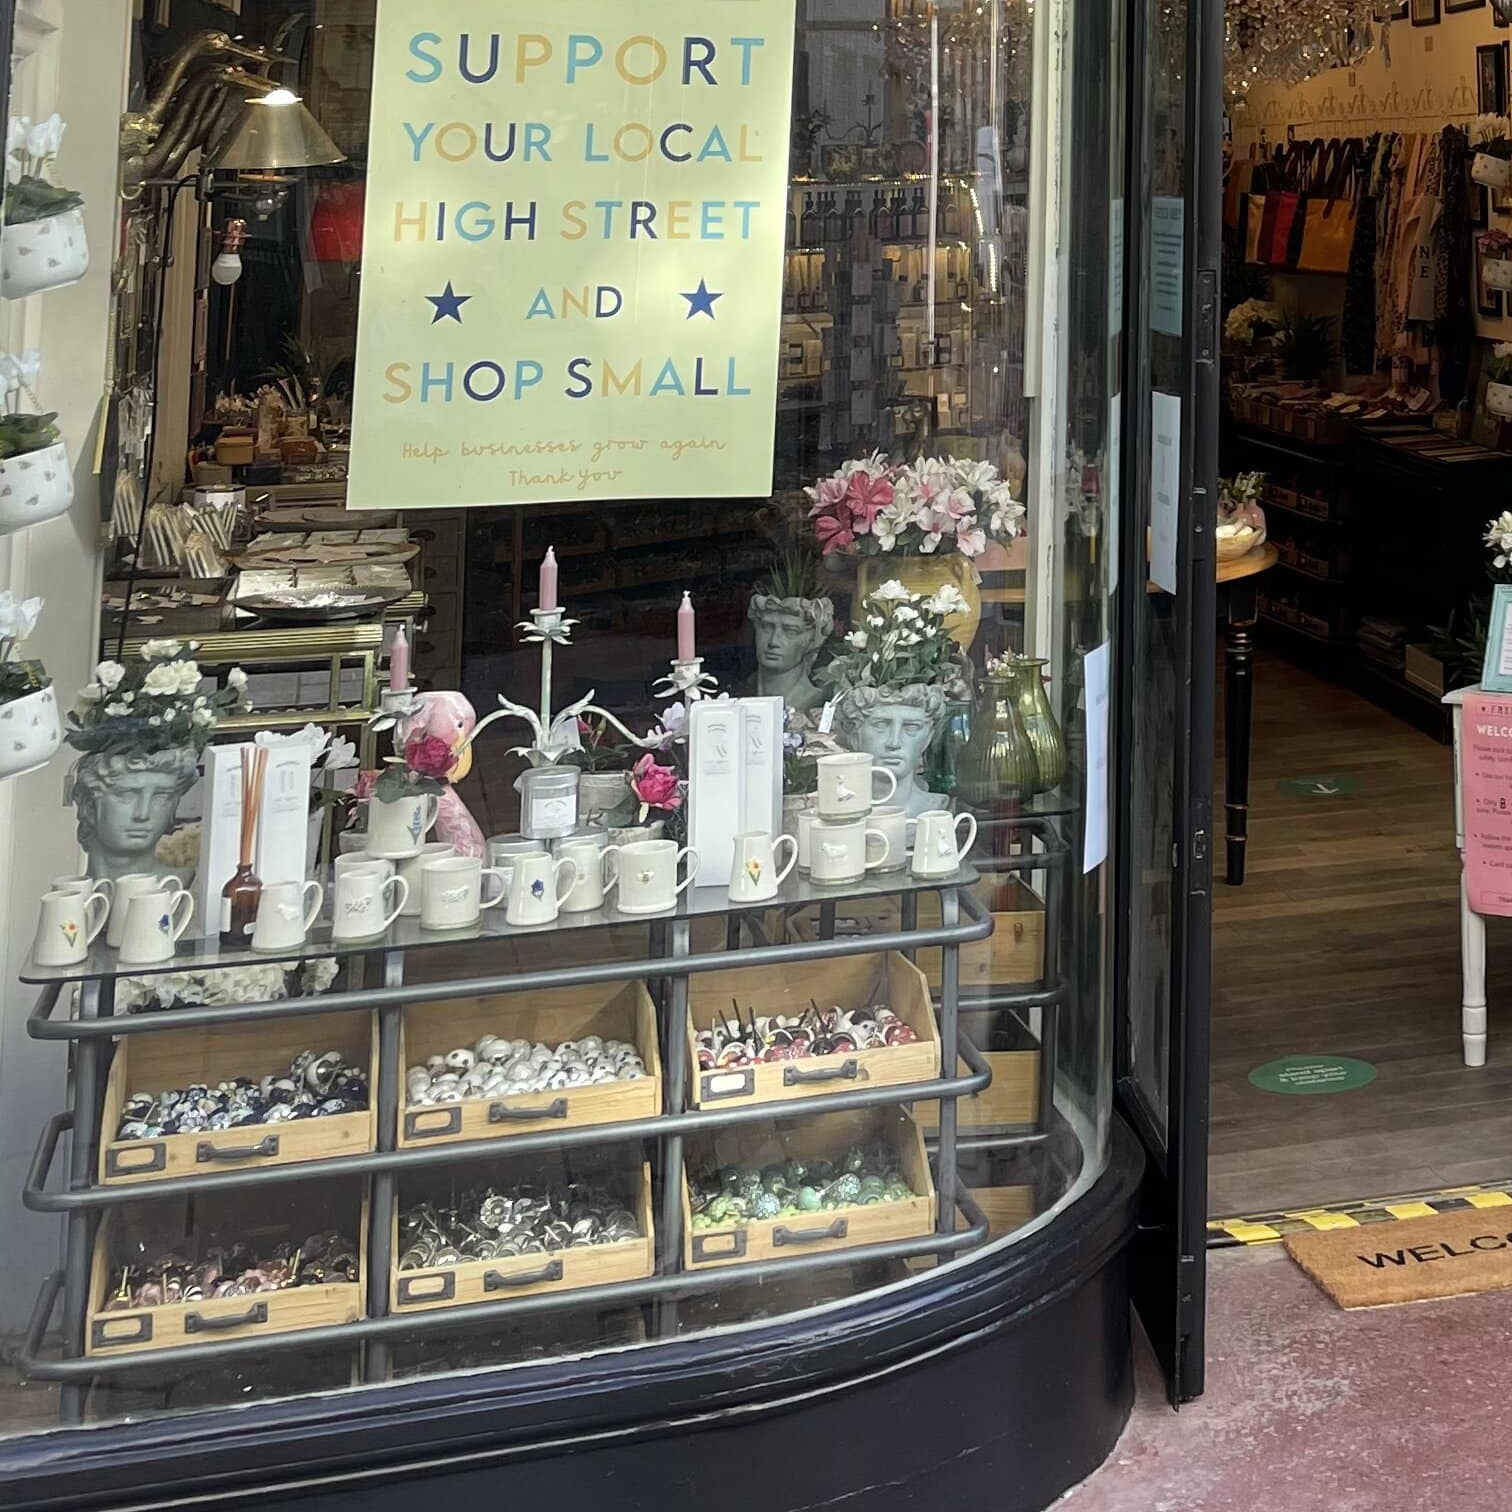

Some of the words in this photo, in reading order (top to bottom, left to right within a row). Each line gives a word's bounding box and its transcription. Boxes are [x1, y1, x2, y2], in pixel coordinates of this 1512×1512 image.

[405, 32, 765, 86] SUPPORT
[402, 122, 553, 163] YOUR
[584, 122, 763, 163] LOCAL
[393, 200, 537, 242] HIGH
[559, 199, 761, 241] STREET
[524, 285, 623, 321] AND
[382, 360, 544, 405] SHOP
[565, 356, 752, 399] SMALL
[401, 442, 449, 464] Help
[461, 439, 583, 457] businesses
[591, 439, 649, 462] grow
[659, 437, 726, 461] again
[509, 467, 575, 486] Thank
